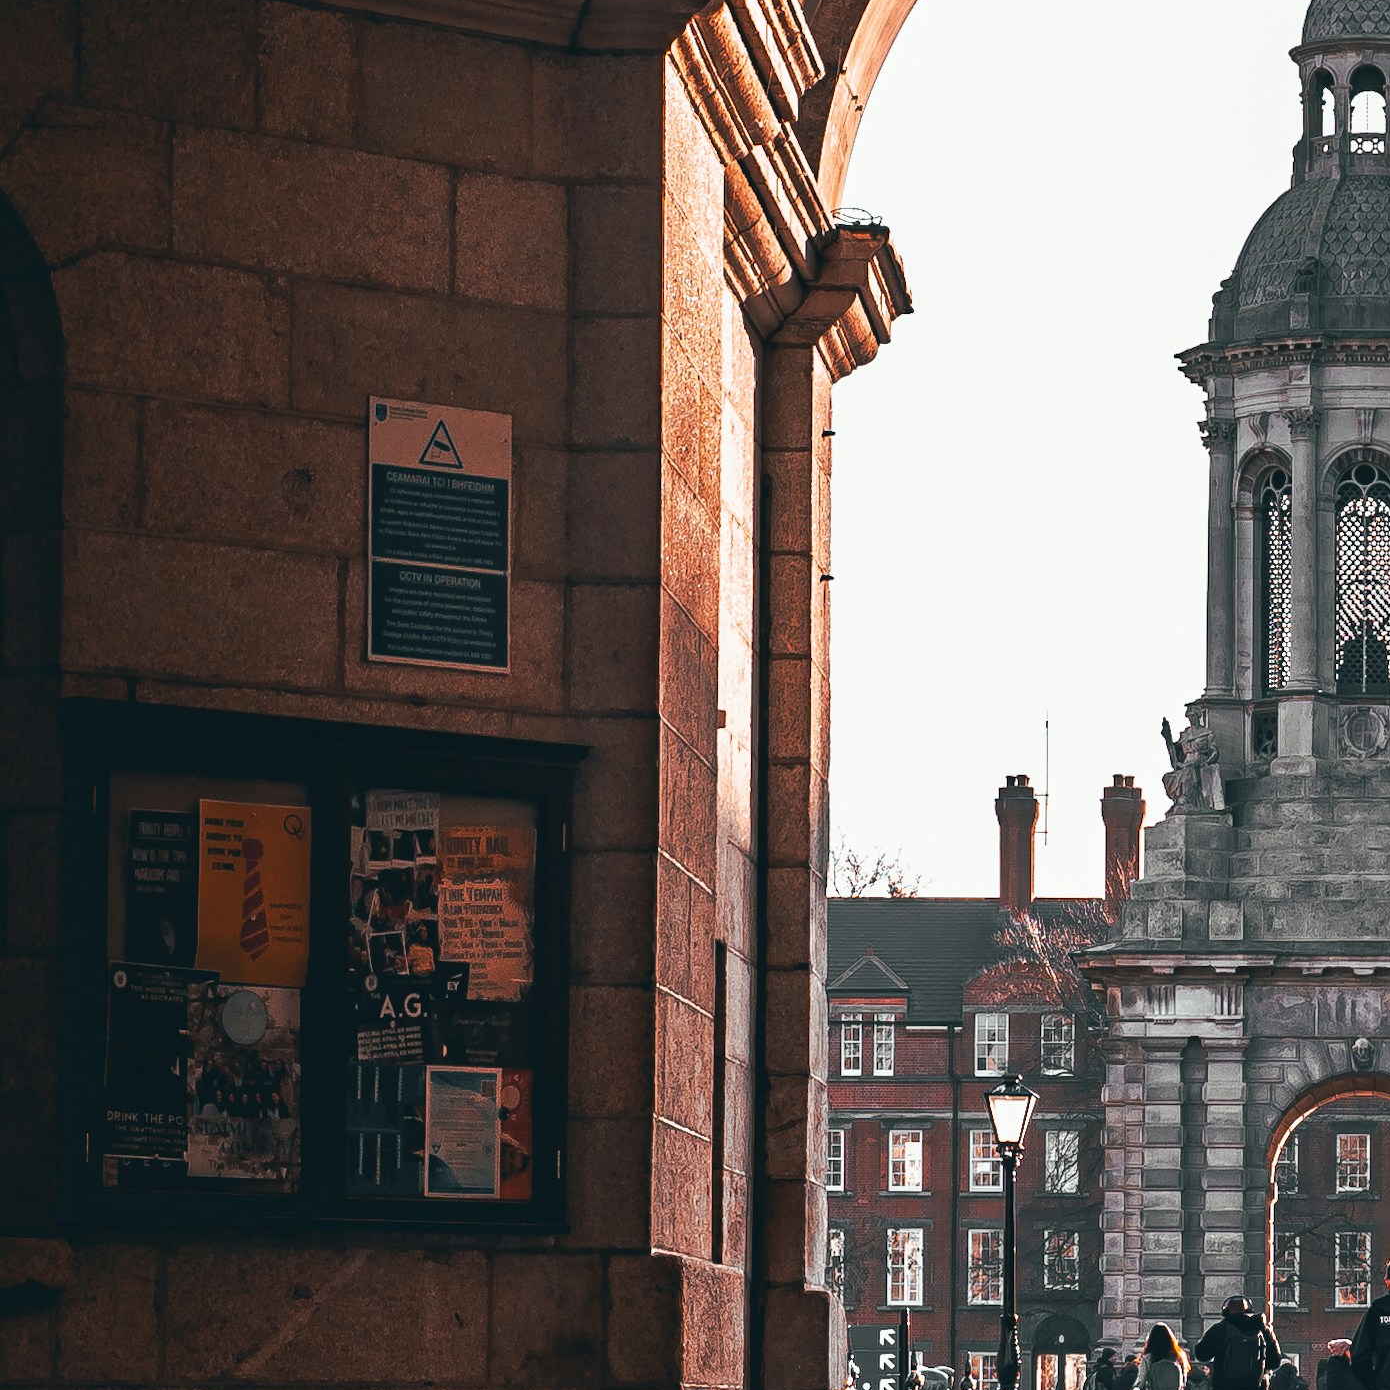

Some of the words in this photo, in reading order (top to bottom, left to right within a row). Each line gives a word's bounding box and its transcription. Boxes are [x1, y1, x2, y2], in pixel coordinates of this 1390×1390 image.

[399, 571, 421, 582] CCTV
[423, 573, 433, 583] IN
[435, 575, 481, 589] OPERATION
[467, 888, 502, 902] TEMPAH
[447, 982, 460, 991] EY
[107, 1110, 138, 1123] DRINK
[145, 1112, 164, 1124] THE
